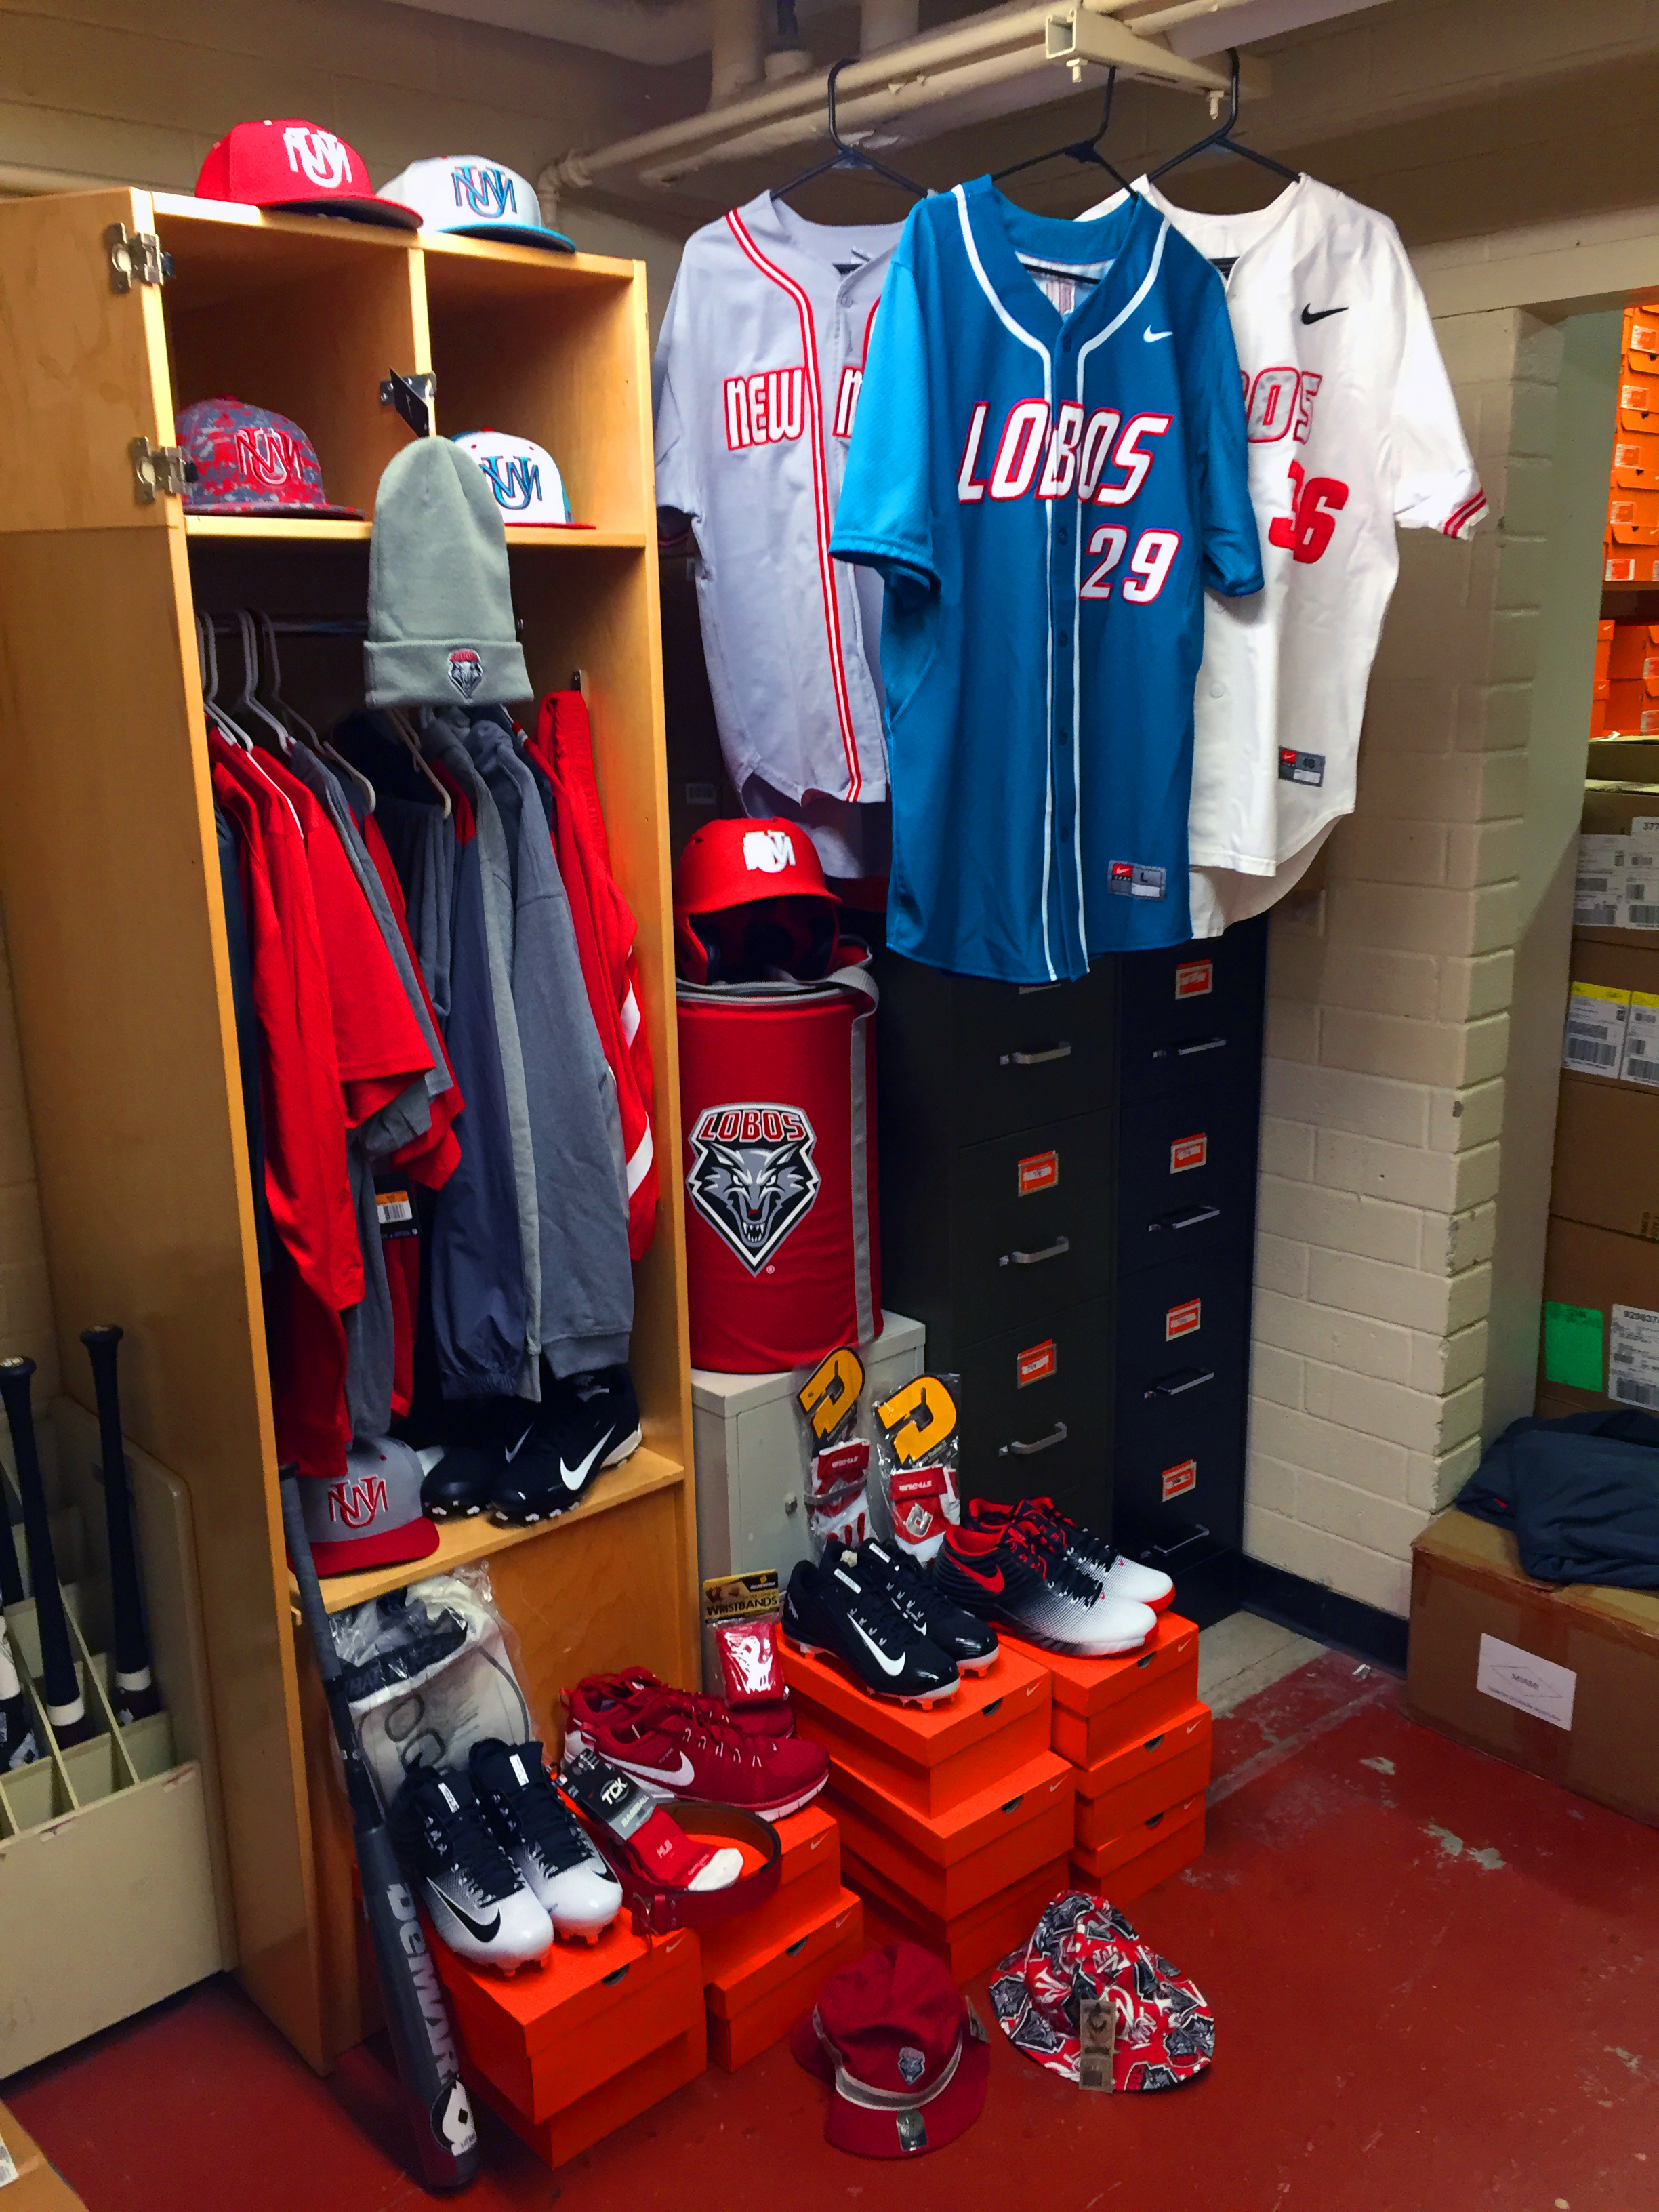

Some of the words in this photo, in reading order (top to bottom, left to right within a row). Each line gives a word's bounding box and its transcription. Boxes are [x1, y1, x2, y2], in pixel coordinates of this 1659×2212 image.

[723, 366, 806, 451] NEW
[956, 398, 1174, 506] LOBOS
[1078, 523, 1181, 605] 29
[698, 1109, 806, 1143] LOBOS
[600, 1776, 628, 1806] TCK
